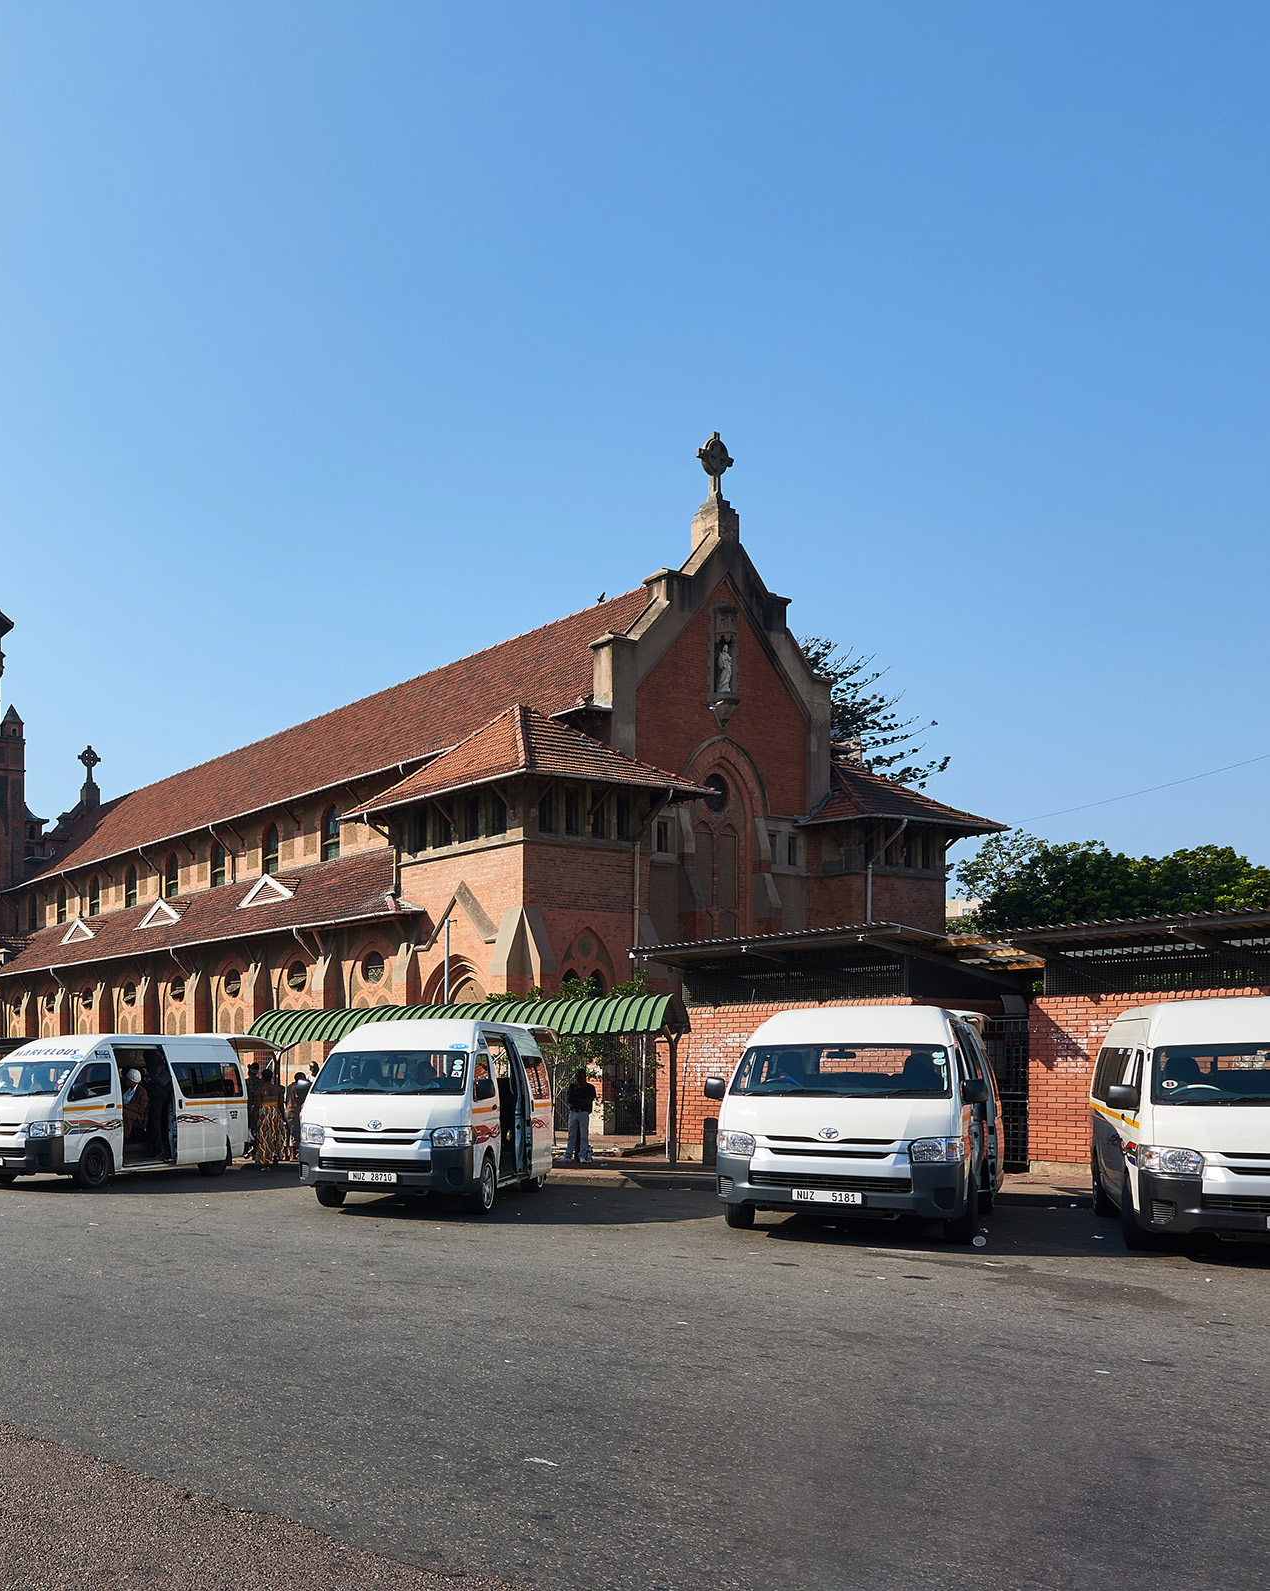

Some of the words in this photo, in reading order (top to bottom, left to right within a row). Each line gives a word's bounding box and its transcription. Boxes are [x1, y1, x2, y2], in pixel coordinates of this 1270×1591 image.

[13, 1048, 80, 1058] MARVELOUS
[352, 1172, 366, 1180] NUZ
[370, 1172, 392, 1182] 28710
[796, 1190, 815, 1200] NUZ
[831, 1192, 856, 1203] 5181
